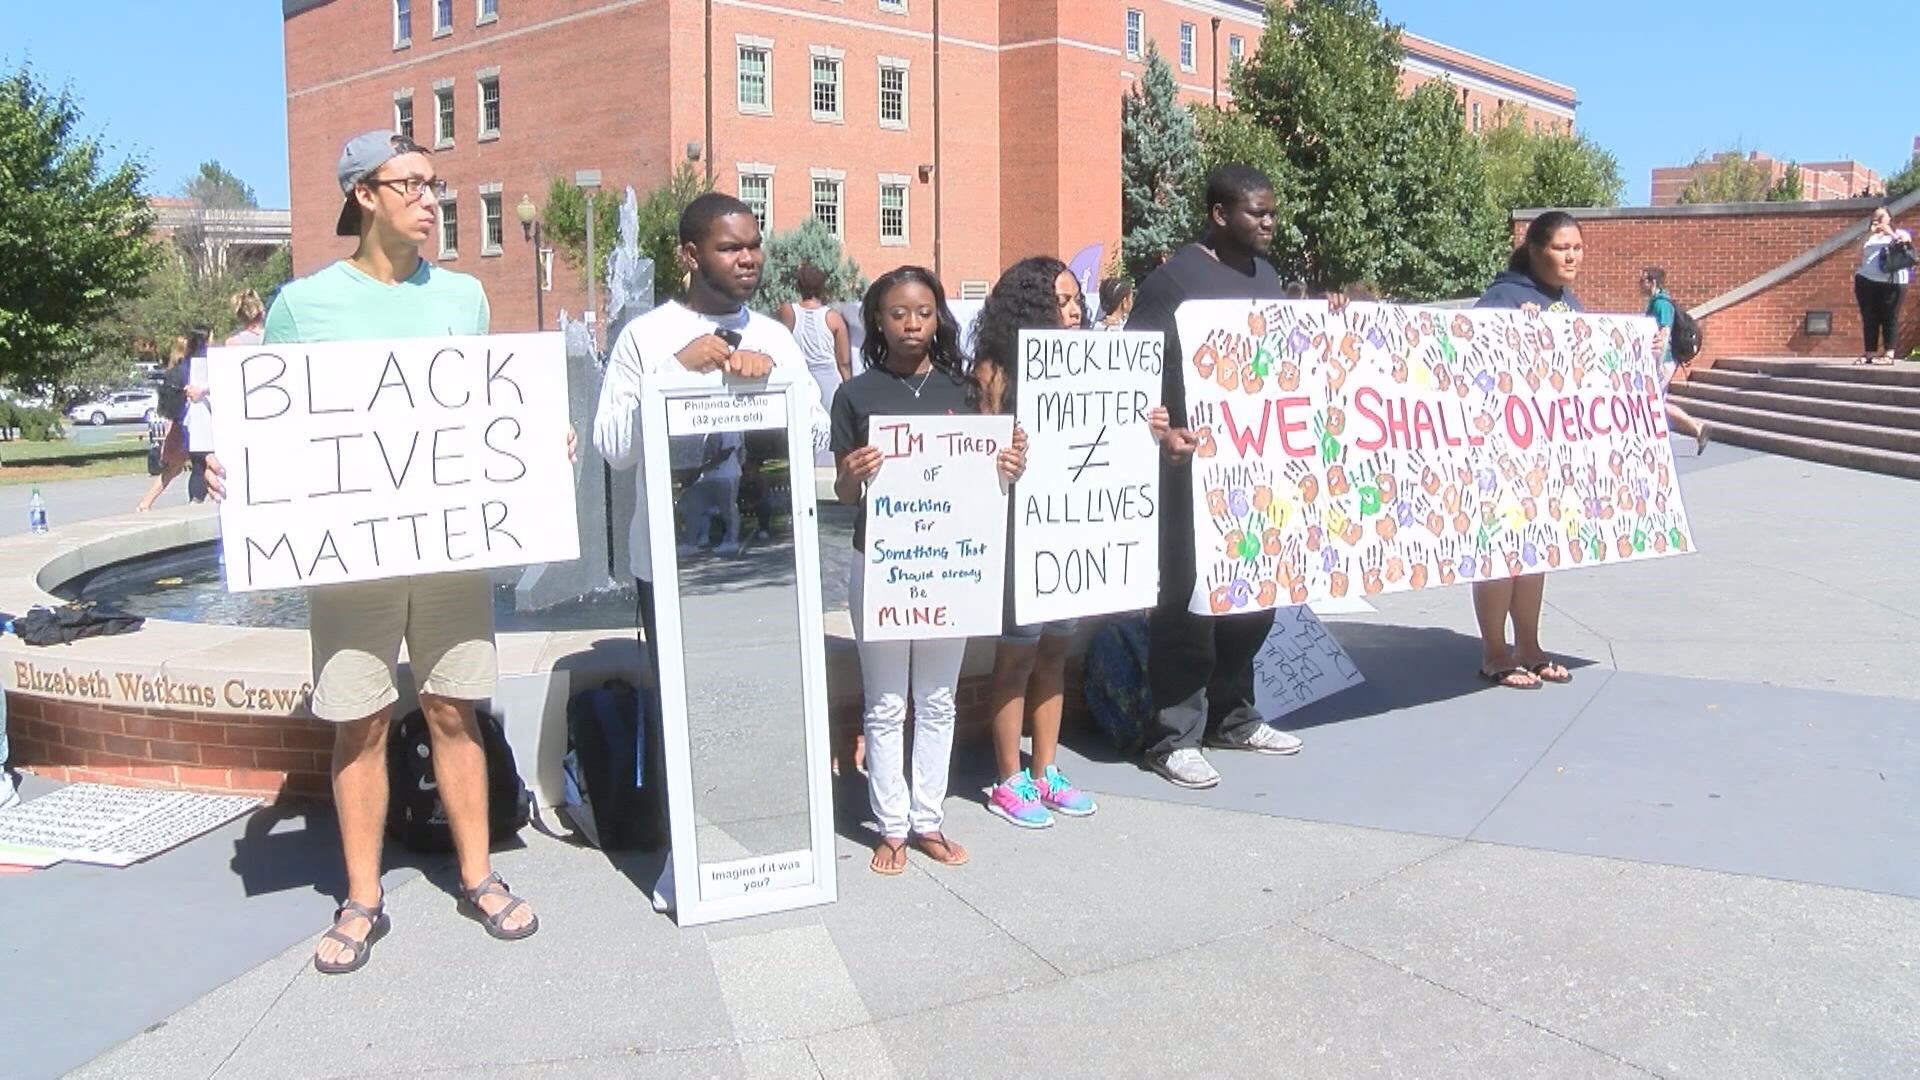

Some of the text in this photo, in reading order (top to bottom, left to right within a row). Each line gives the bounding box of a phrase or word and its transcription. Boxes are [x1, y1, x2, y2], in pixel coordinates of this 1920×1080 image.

[1026, 338, 1162, 382] BLACK LIVES
[241, 348, 523, 420] BLACK
[684, 399, 730, 411] Philando
[712, 413, 741, 426] years
[743, 411, 763, 423] old)
[1038, 389, 1148, 433] MATTER
[1220, 387, 1667, 458] WE SHALL OVERCOME
[879, 423, 997, 459] I'M TIRED
[245, 417, 526, 506] LIVES
[923, 465, 942, 482] OF
[1026, 483, 1154, 526] ALL LIVES
[245, 500, 522, 586] MATTER
[956, 538, 987, 558] That
[887, 566, 982, 584] Should already
[1036, 541, 1139, 598] DON'T
[910, 586, 927, 599] Be
[878, 606, 955, 627] MINE.
[14, 661, 111, 698] Elizabeth
[115, 672, 216, 708] Watkins
[712, 861, 800, 880] Imagine if it was
[743, 877, 770, 892] you?
